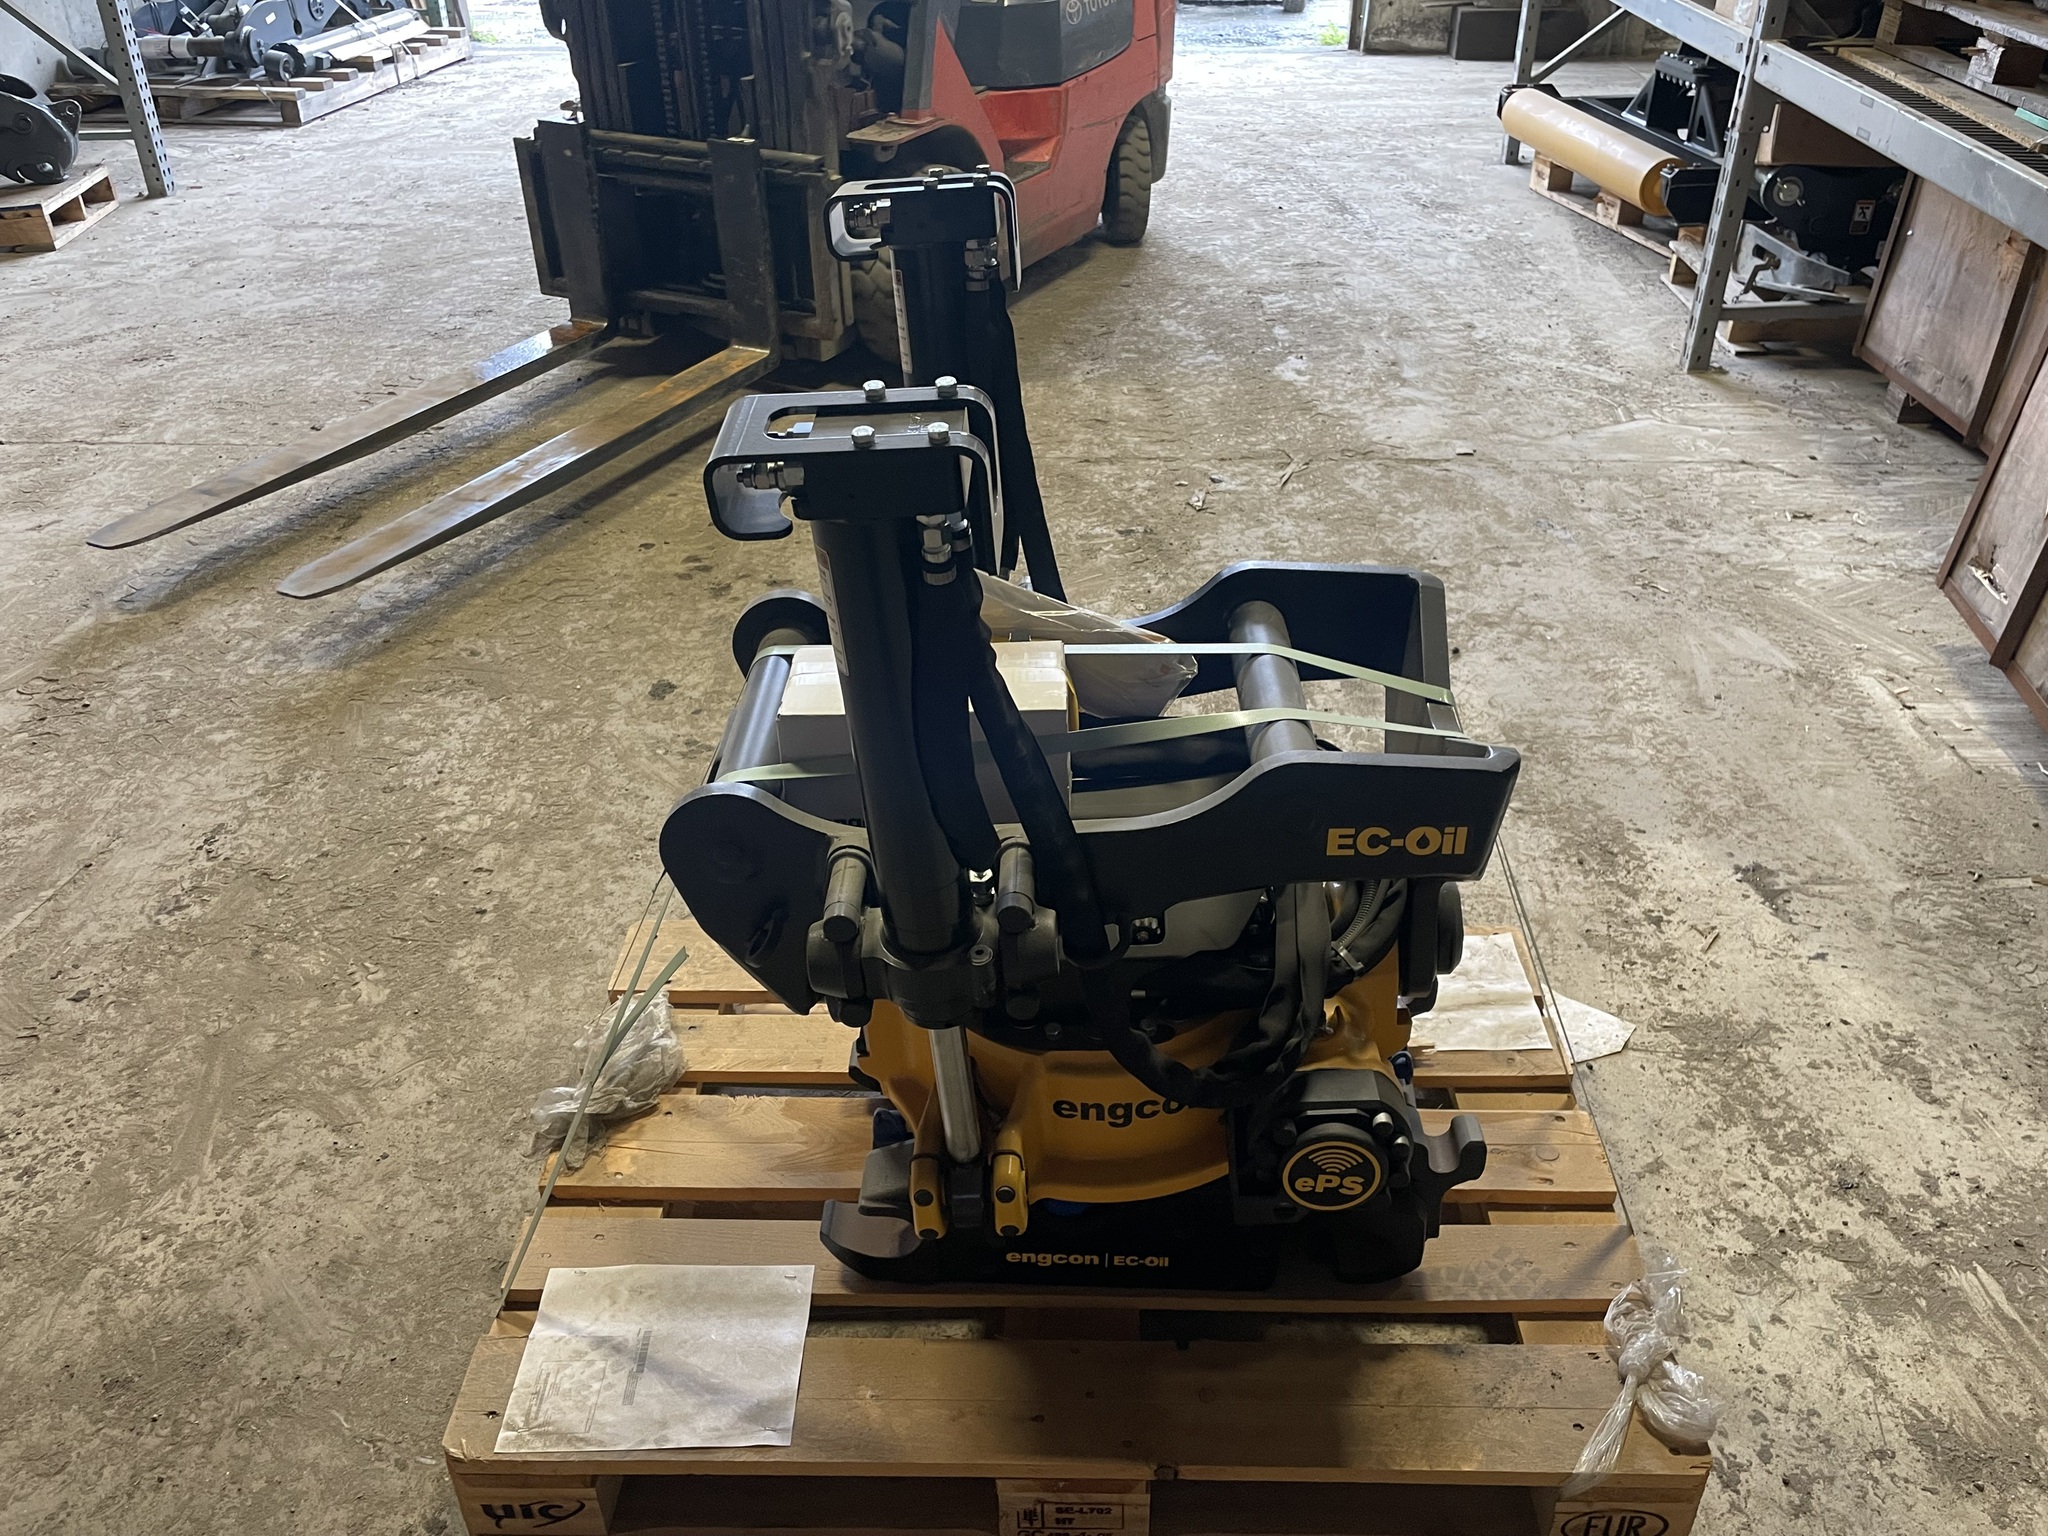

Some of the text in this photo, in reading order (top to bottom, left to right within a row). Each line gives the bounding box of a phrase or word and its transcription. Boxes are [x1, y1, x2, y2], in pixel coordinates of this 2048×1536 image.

[1326, 826, 1468, 856] EC-Oil
[1052, 1099, 1188, 1128] engco
[1294, 1174, 1365, 1196] ePS
[1005, 1252, 1099, 1267] engcon
